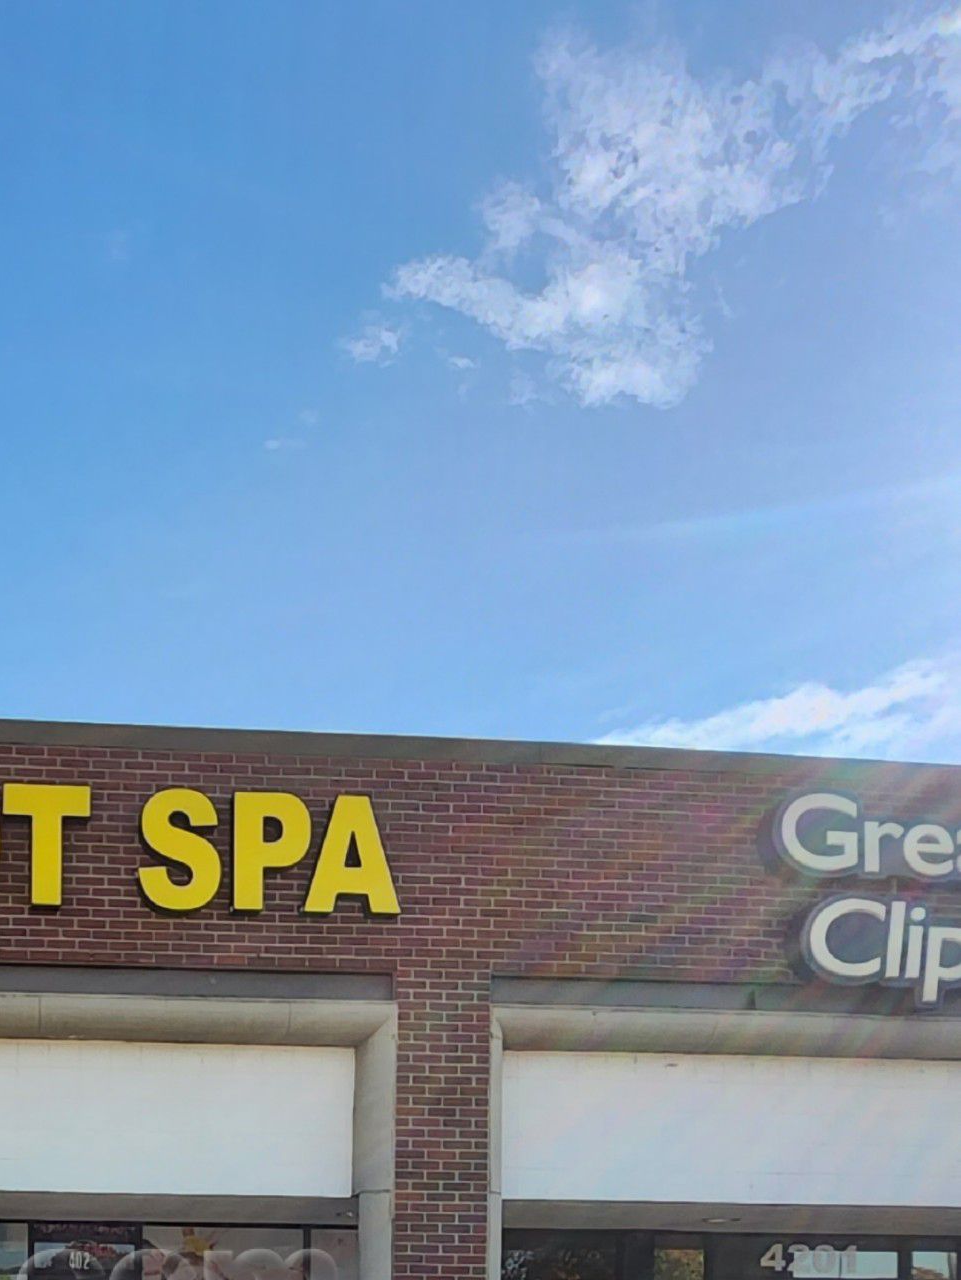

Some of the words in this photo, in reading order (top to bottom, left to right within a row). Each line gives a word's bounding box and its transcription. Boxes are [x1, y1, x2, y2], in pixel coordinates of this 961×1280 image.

[138, 787, 401, 915] SPA
[782, 793, 961, 877] Gre
[760, 1243, 858, 1275] 4201
